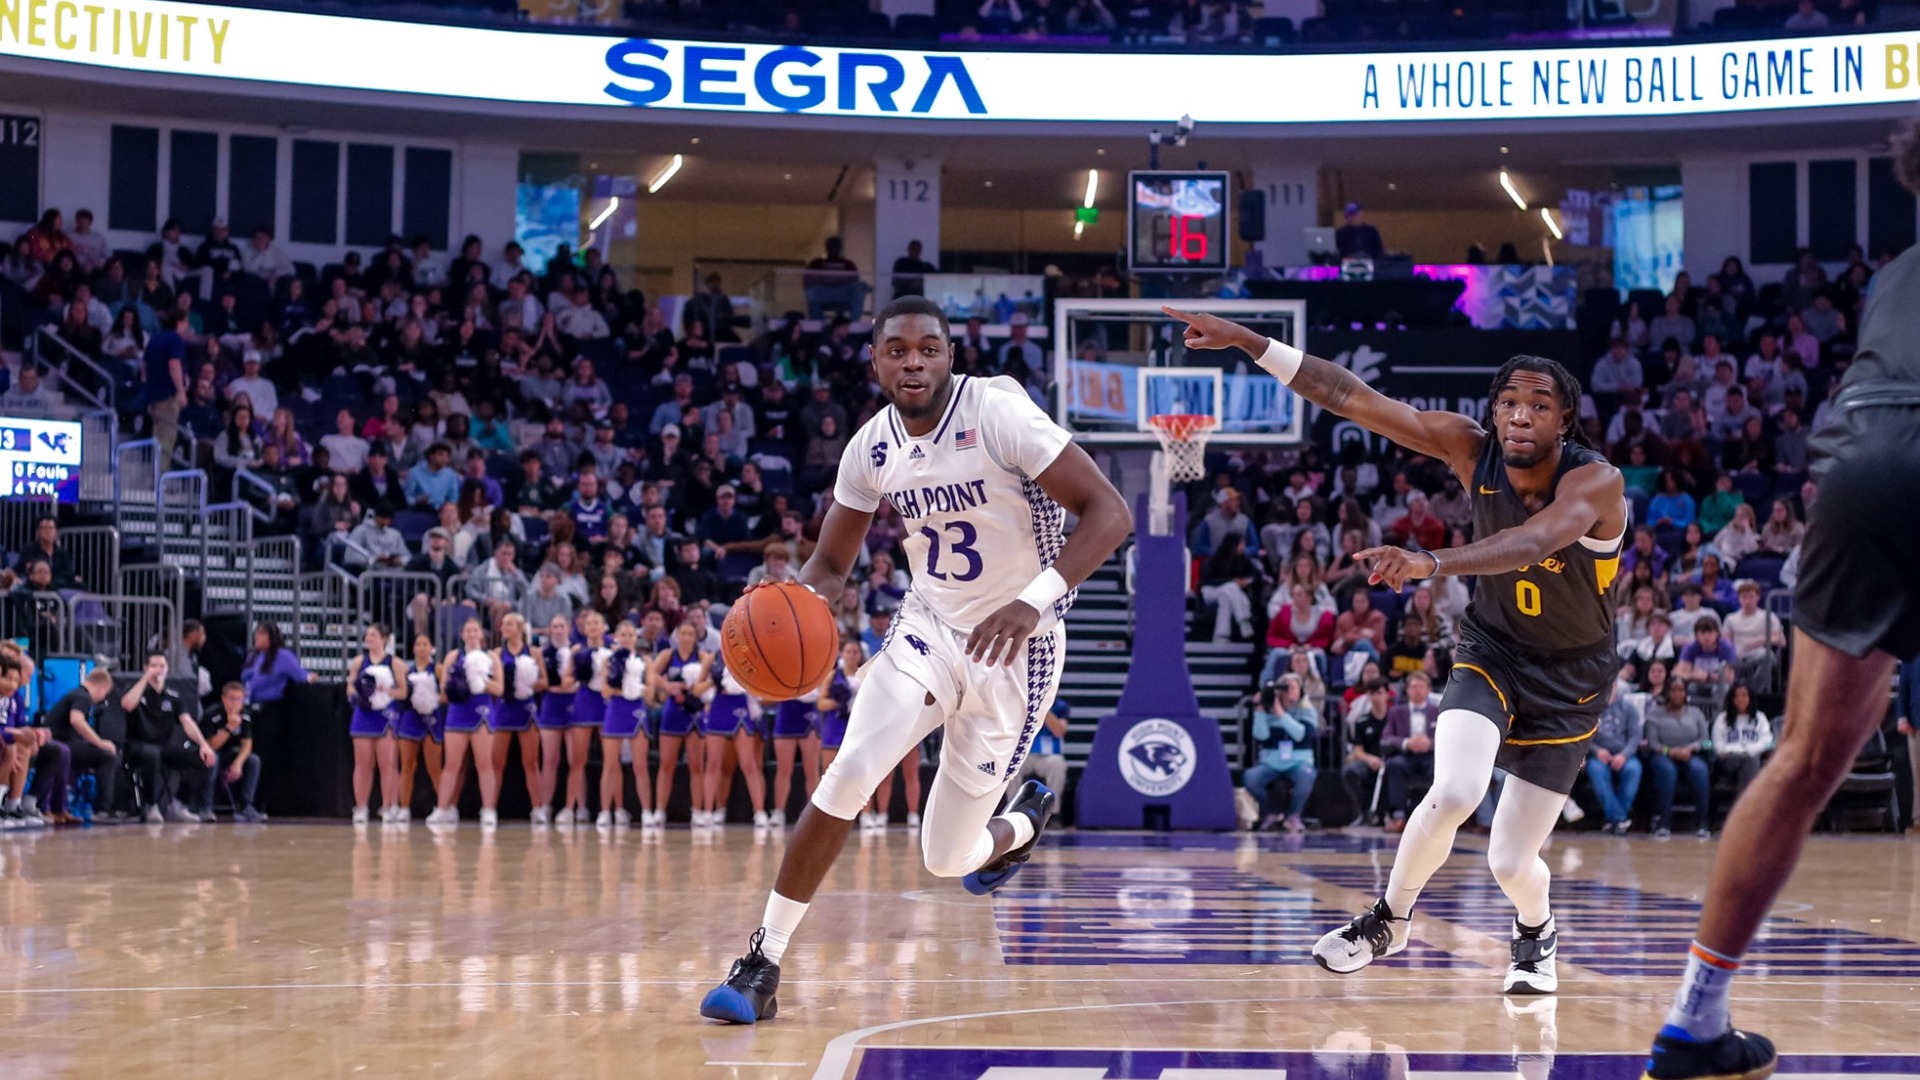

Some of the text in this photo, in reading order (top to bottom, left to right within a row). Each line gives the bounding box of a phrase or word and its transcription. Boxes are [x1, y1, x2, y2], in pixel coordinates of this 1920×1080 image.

[0, 0, 230, 64] NECTIVITY
[602, 38, 988, 114] SEGRA
[1363, 43, 1920, 109] A WHOLE NEW BALL GAME IN B
[889, 179, 930, 202] 112
[1270, 184, 1304, 206] 111
[1169, 213, 1208, 260] 16
[0, 428, 15, 449] 3
[15, 462, 69, 481] 0 Fouls
[921, 479, 988, 516] POINT
[1515, 579, 1542, 617] 0
